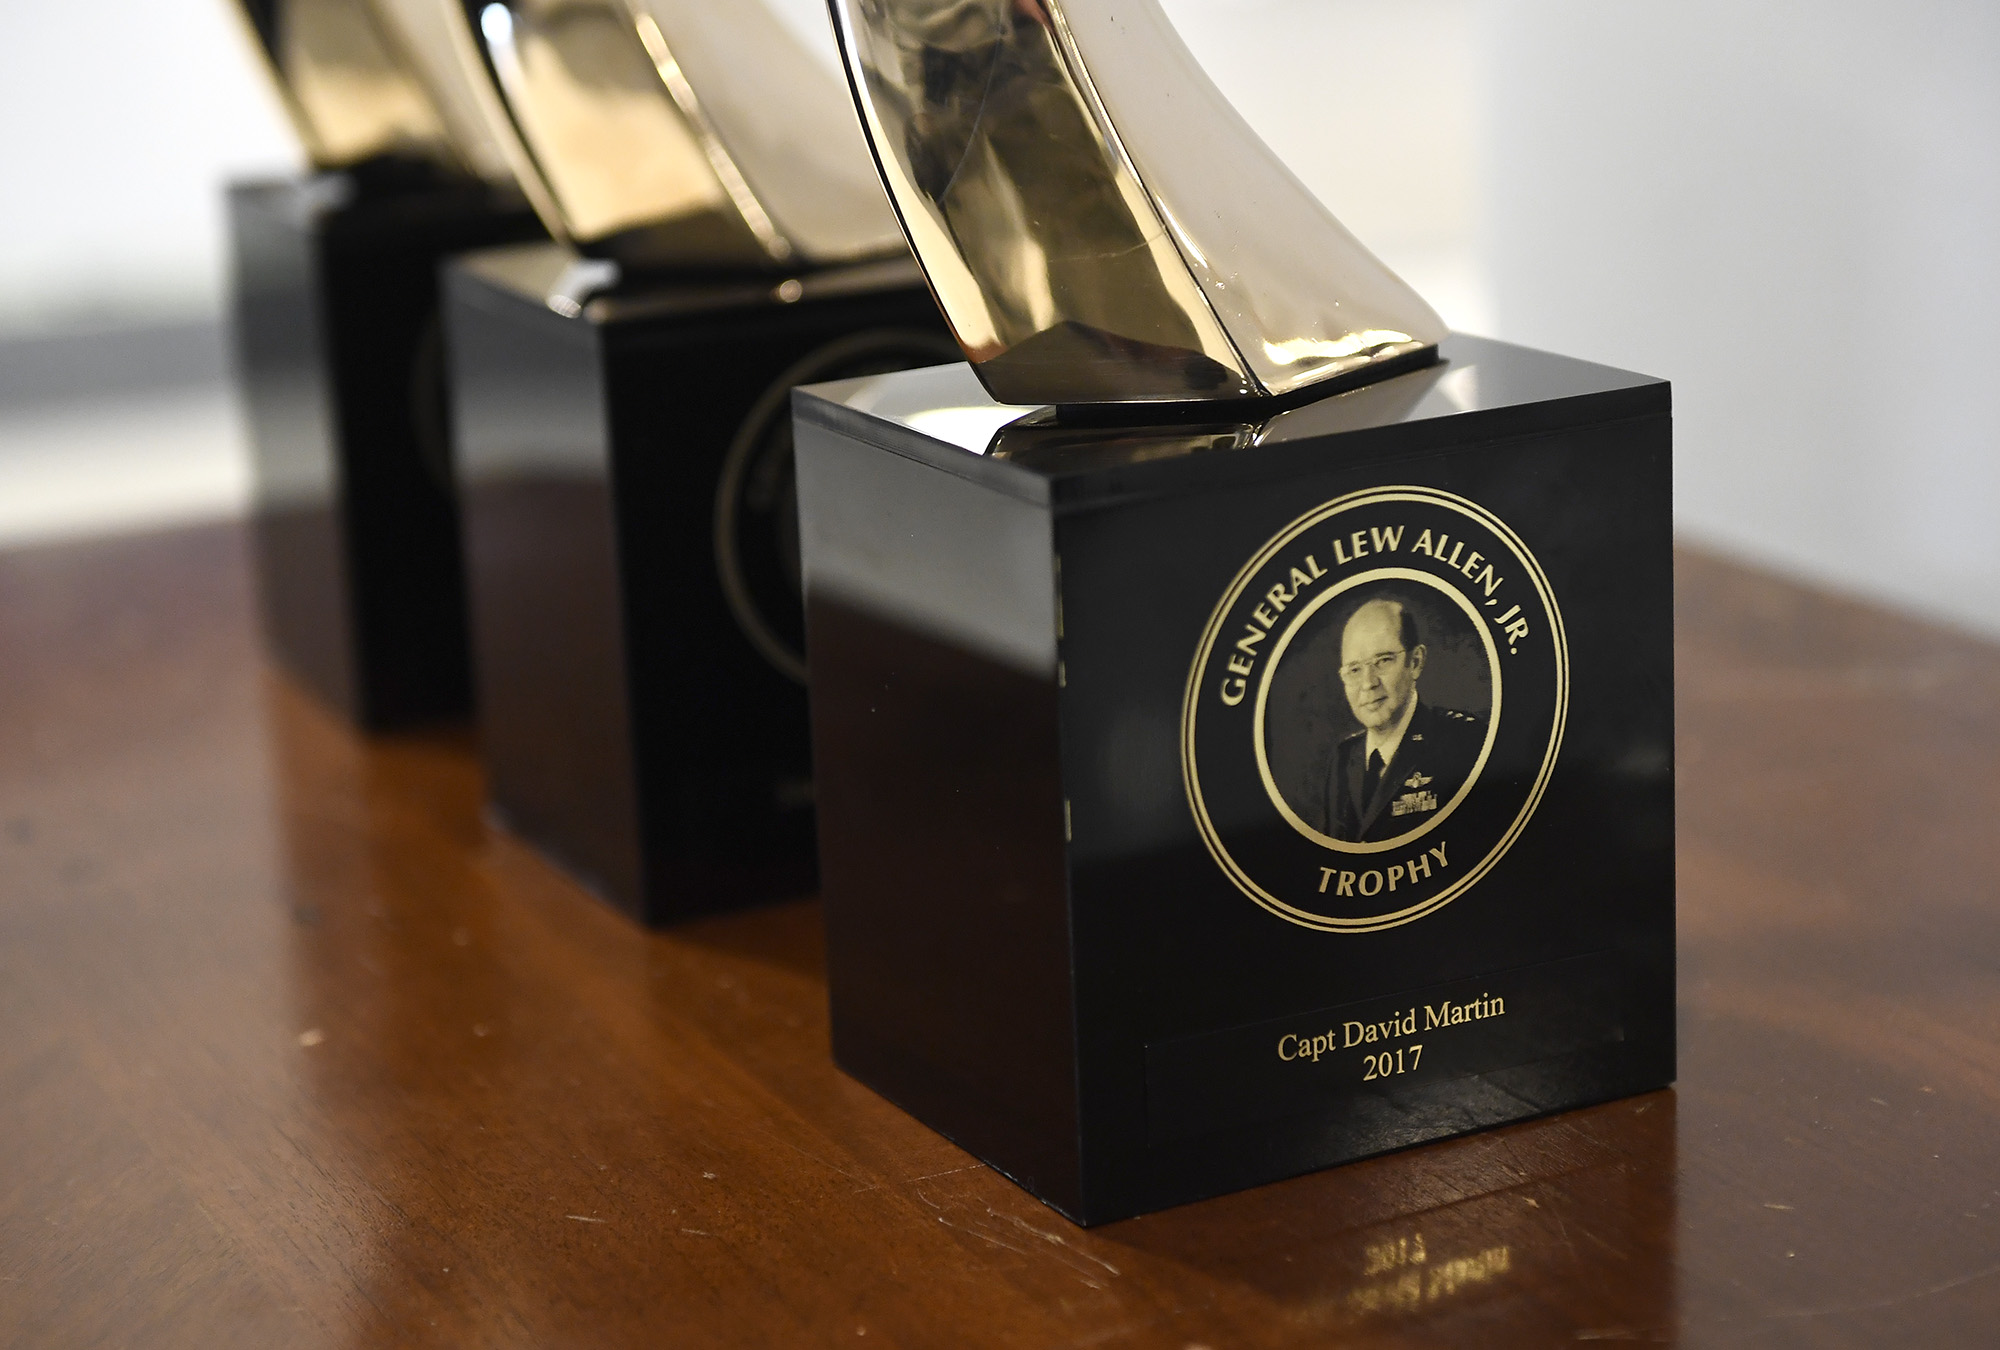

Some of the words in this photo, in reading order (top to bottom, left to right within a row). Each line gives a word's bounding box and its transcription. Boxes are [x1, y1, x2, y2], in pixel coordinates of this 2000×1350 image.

[1221, 554, 1328, 707] GENERAL
[1333, 525, 1405, 566] LEW
[1411, 528, 1504, 606] ALLEN,
[1493, 603, 1530, 656] JR.
[1317, 841, 1450, 897] TROPHY
[1277, 1029, 1336, 1063] Capt
[1342, 1007, 1418, 1049] David
[1423, 992, 1506, 1031] Martin
[1362, 1044, 1423, 1081] 2017
